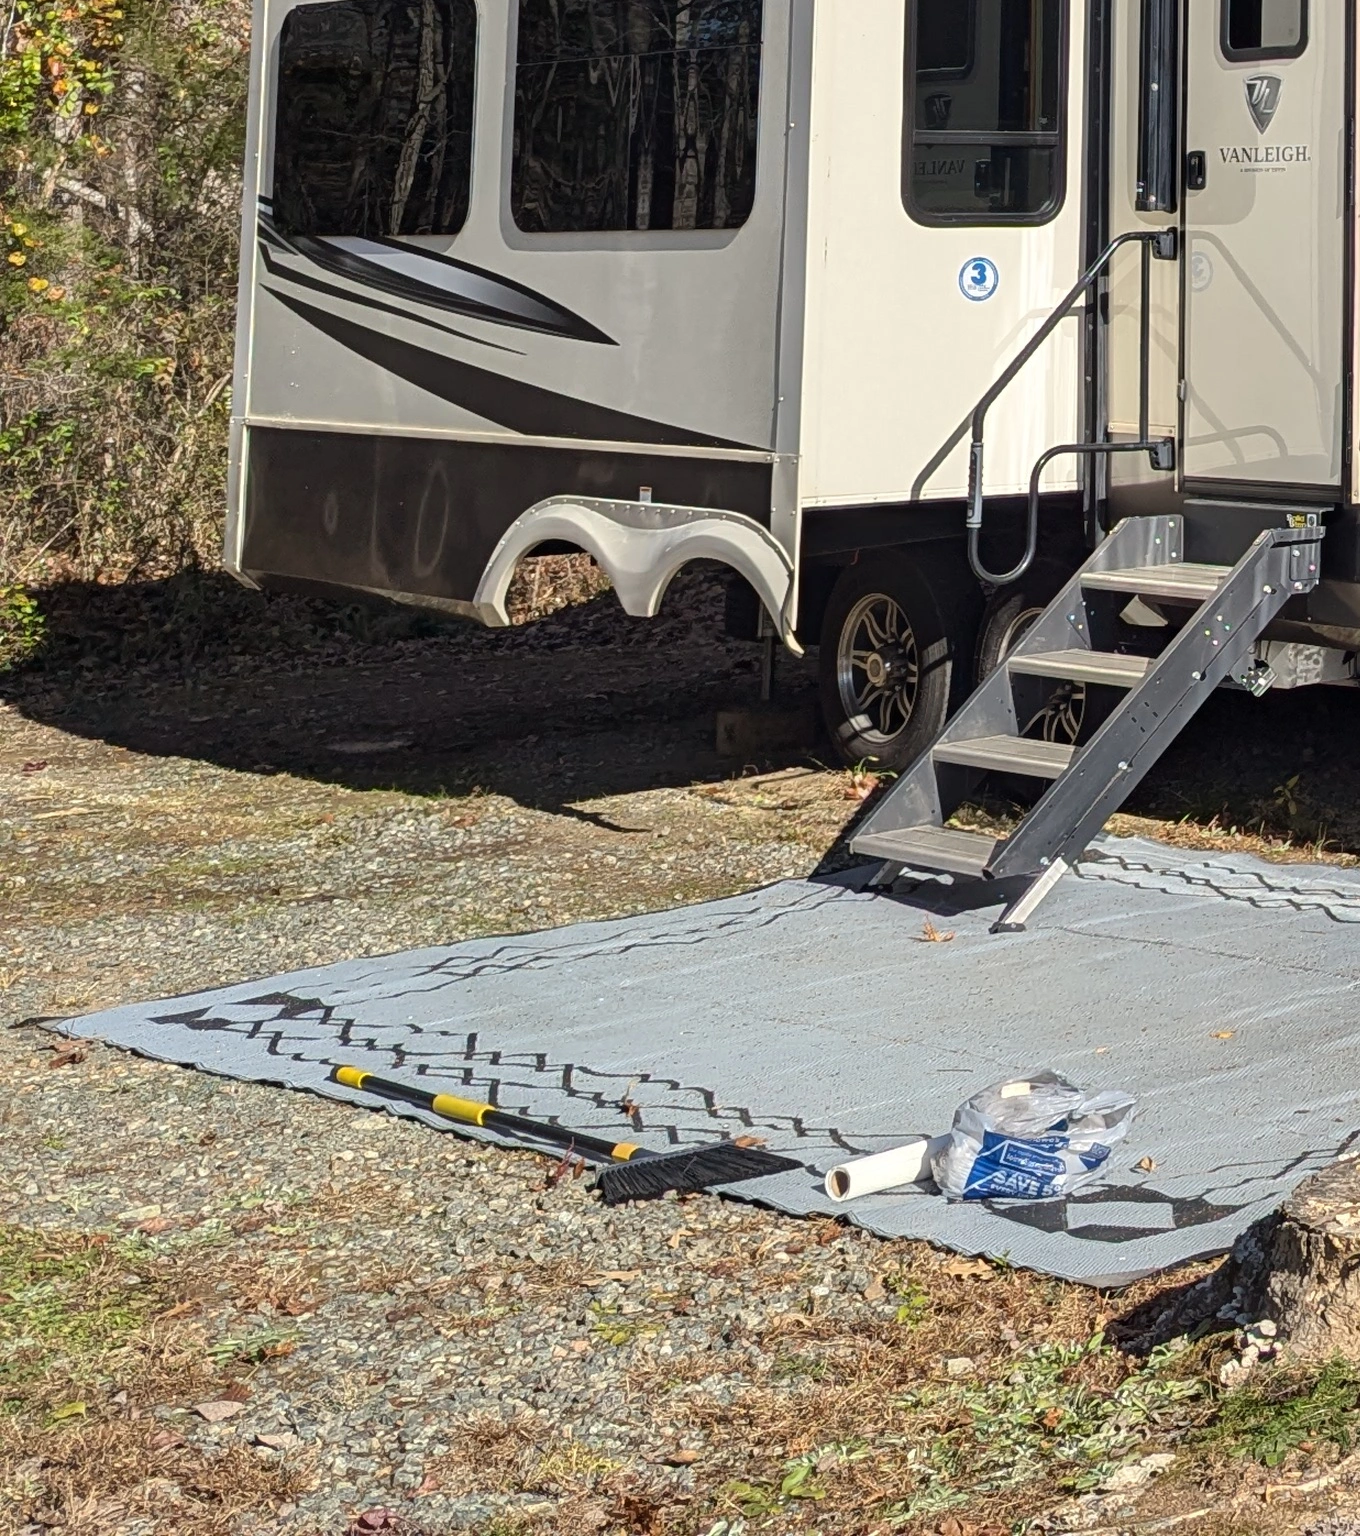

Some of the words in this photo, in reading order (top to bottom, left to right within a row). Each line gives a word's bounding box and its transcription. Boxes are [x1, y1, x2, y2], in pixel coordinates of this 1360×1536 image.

[1219, 146, 1308, 163] VANLEIGH
[970, 262, 987, 286] 3
[992, 1170, 1041, 1196] SAVE
